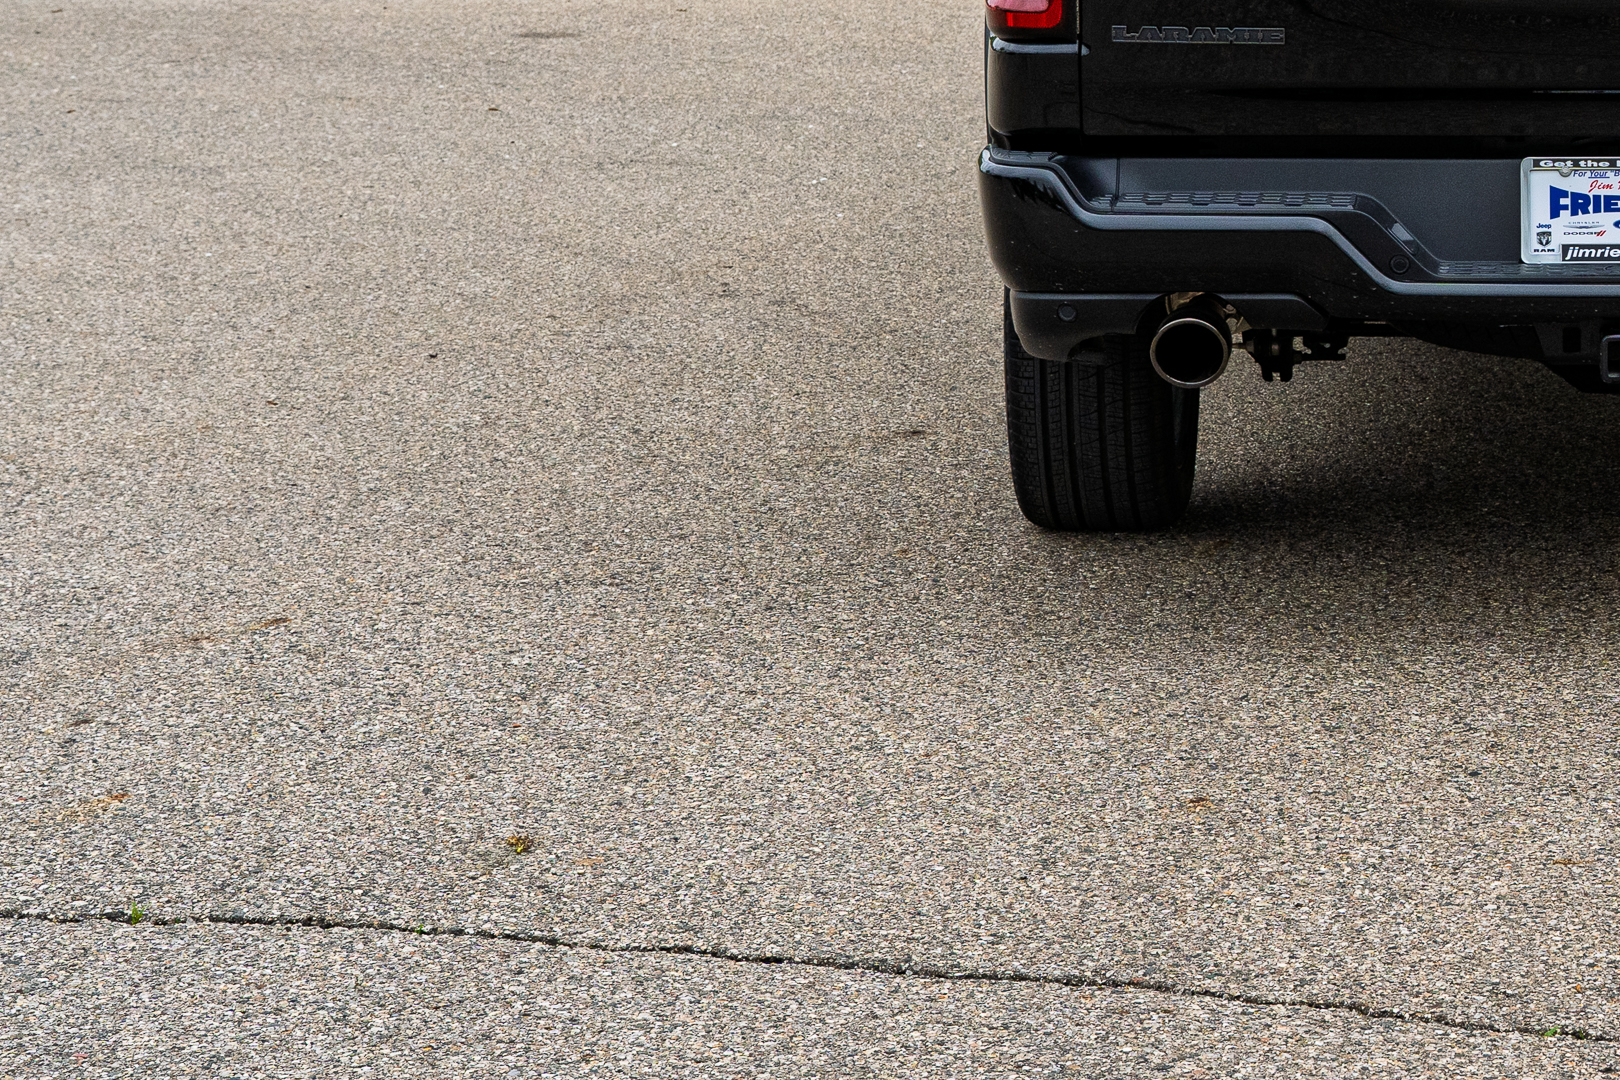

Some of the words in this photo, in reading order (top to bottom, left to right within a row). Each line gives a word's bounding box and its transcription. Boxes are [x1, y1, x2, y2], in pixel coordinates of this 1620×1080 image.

[1112, 25, 1286, 44] LARAMIE
[1588, 170, 1608, 178] Your
[1588, 180, 1614, 193] Jim
